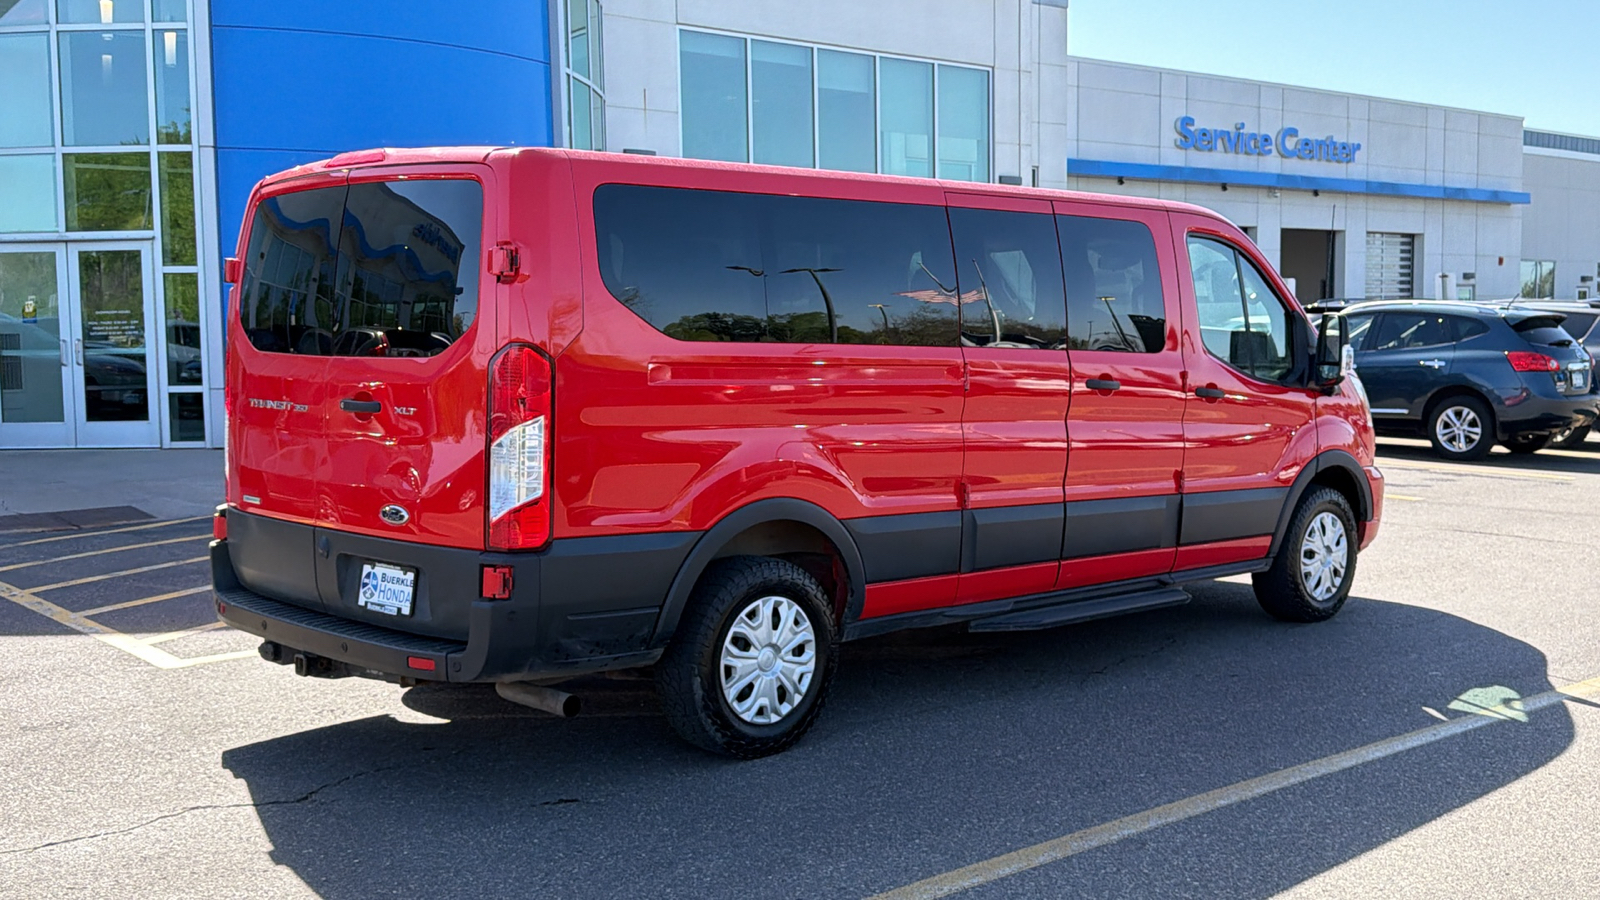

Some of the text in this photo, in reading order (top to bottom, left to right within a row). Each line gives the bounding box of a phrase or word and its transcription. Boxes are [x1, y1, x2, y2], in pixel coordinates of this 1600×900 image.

[1174, 115, 1362, 163] Service Center
[249, 398, 293, 411] TRANSIT
[394, 406, 417, 416] XLT
[377, 583, 412, 604] HONDA
